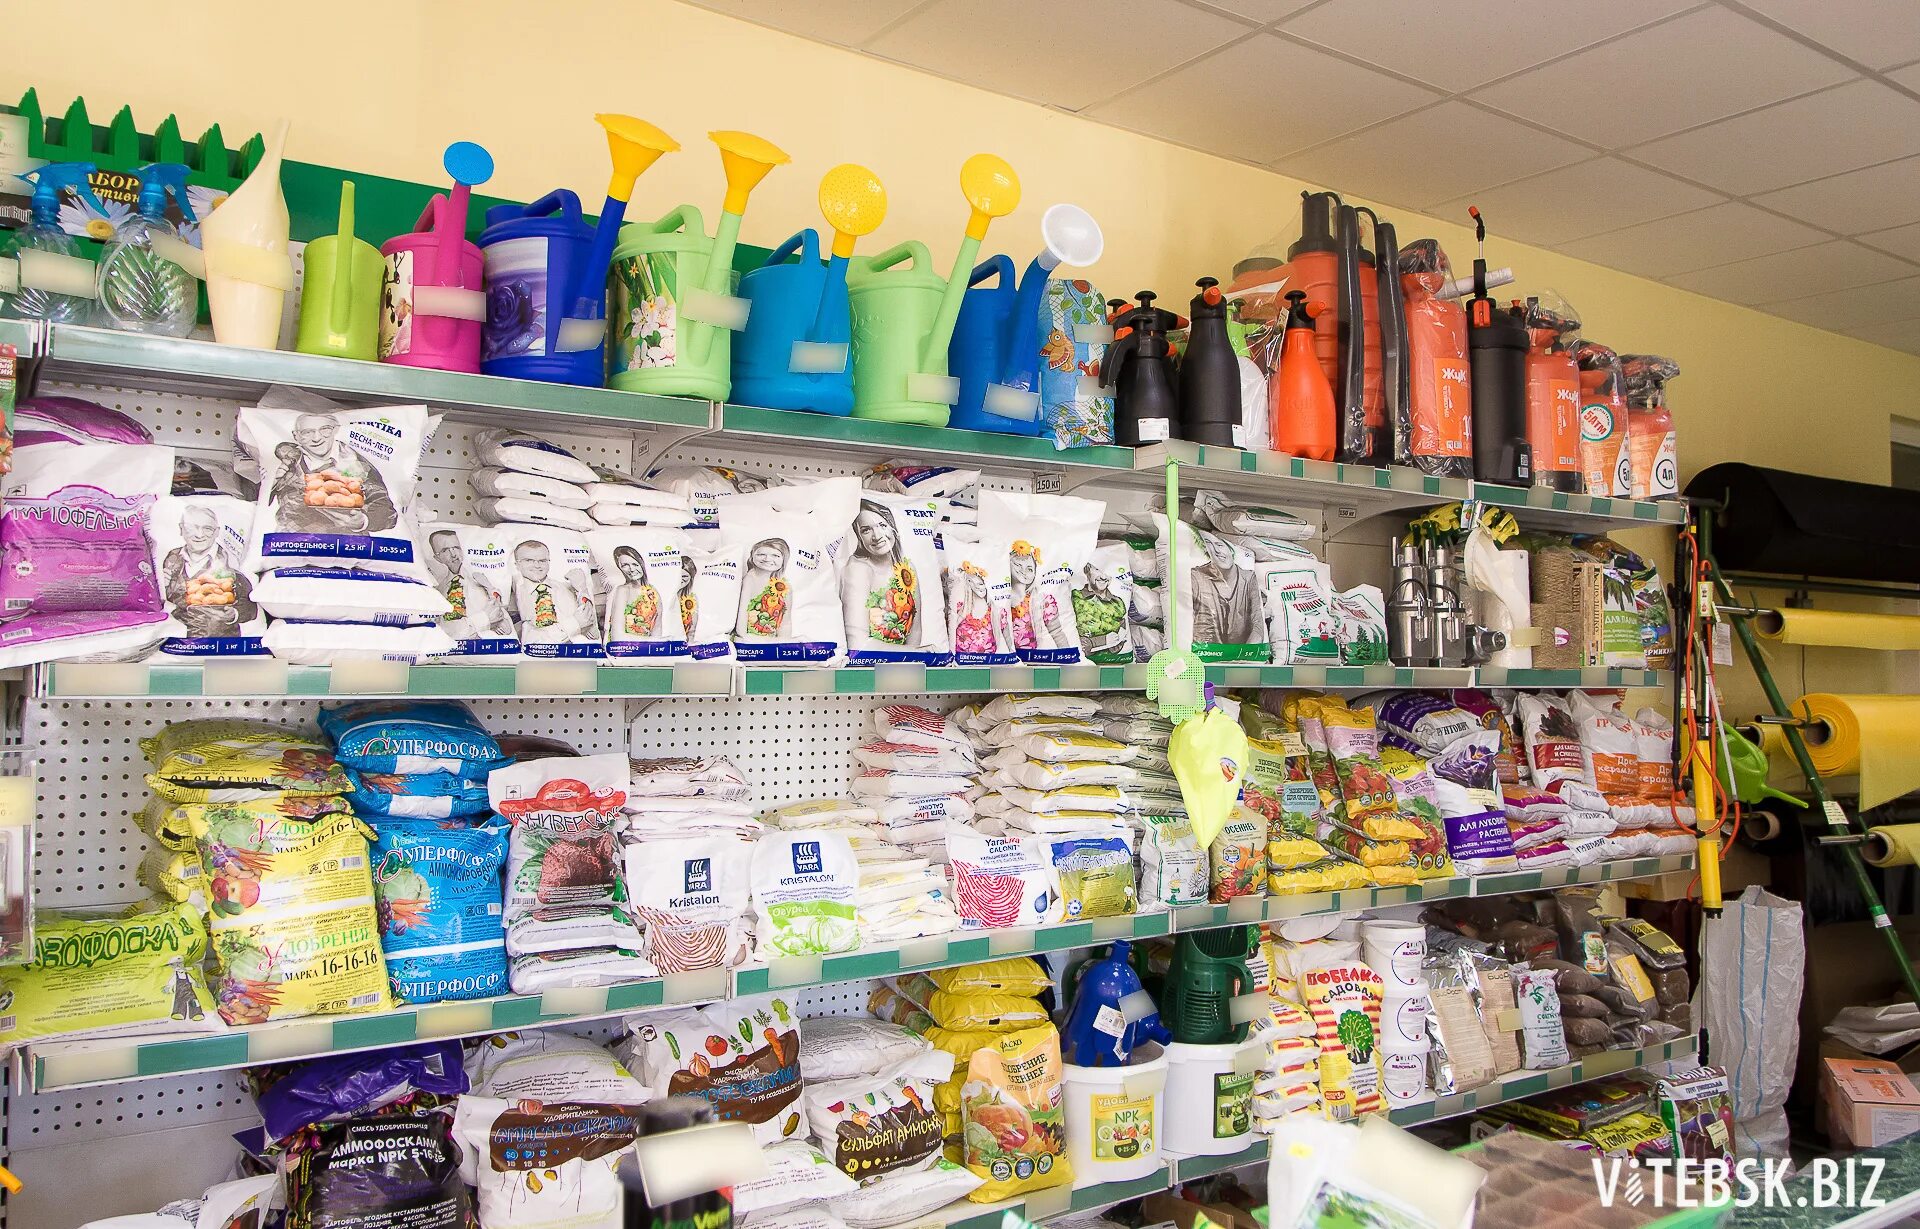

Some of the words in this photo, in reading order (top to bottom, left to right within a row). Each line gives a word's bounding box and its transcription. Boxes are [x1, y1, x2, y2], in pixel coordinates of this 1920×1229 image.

[1441, 367, 1467, 384] Жук
[350, 430, 394, 455] ВЕСНА-ЛЕТО
[1037, 479, 1050, 490] 150
[13, 506, 140, 531] КАРТОФЕЛЬНО
[904, 509, 937, 518] FERT
[912, 528, 934, 537] ВЕСН
[468, 548, 506, 556] FERTIKA
[1459, 821, 1477, 833] ДЛЯ
[275, 845, 308, 854] МАРКА
[311, 817, 360, 847] 16-16-1
[377, 843, 504, 884] СУПЕРФОСФАТ
[796, 863, 820, 873] YARA
[686, 881, 709, 891] YARA
[779, 873, 835, 887] KRISTALON
[669, 893, 721, 908] Kristalon
[285, 969, 318, 981] МАРКА
[322, 947, 378, 976] 16-16-16
[1321, 982, 1376, 1004] САДОВАЯ
[1098, 1096, 1128, 1107] УДОБ
[543, 1109, 600, 1123] УДОБРИТЕЛЬНАЯ
[1114, 1109, 1140, 1124] NPK
[352, 1125, 375, 1133] СМЕСЬ
[841, 1129, 895, 1152] СУЛЬФАТ
[328, 1154, 375, 1170] марка
[378, 1148, 408, 1163] NPK
[411, 1147, 446, 1163] 5-16-35
[364, 1212, 393, 1222] ЯГОДНЫЕ
